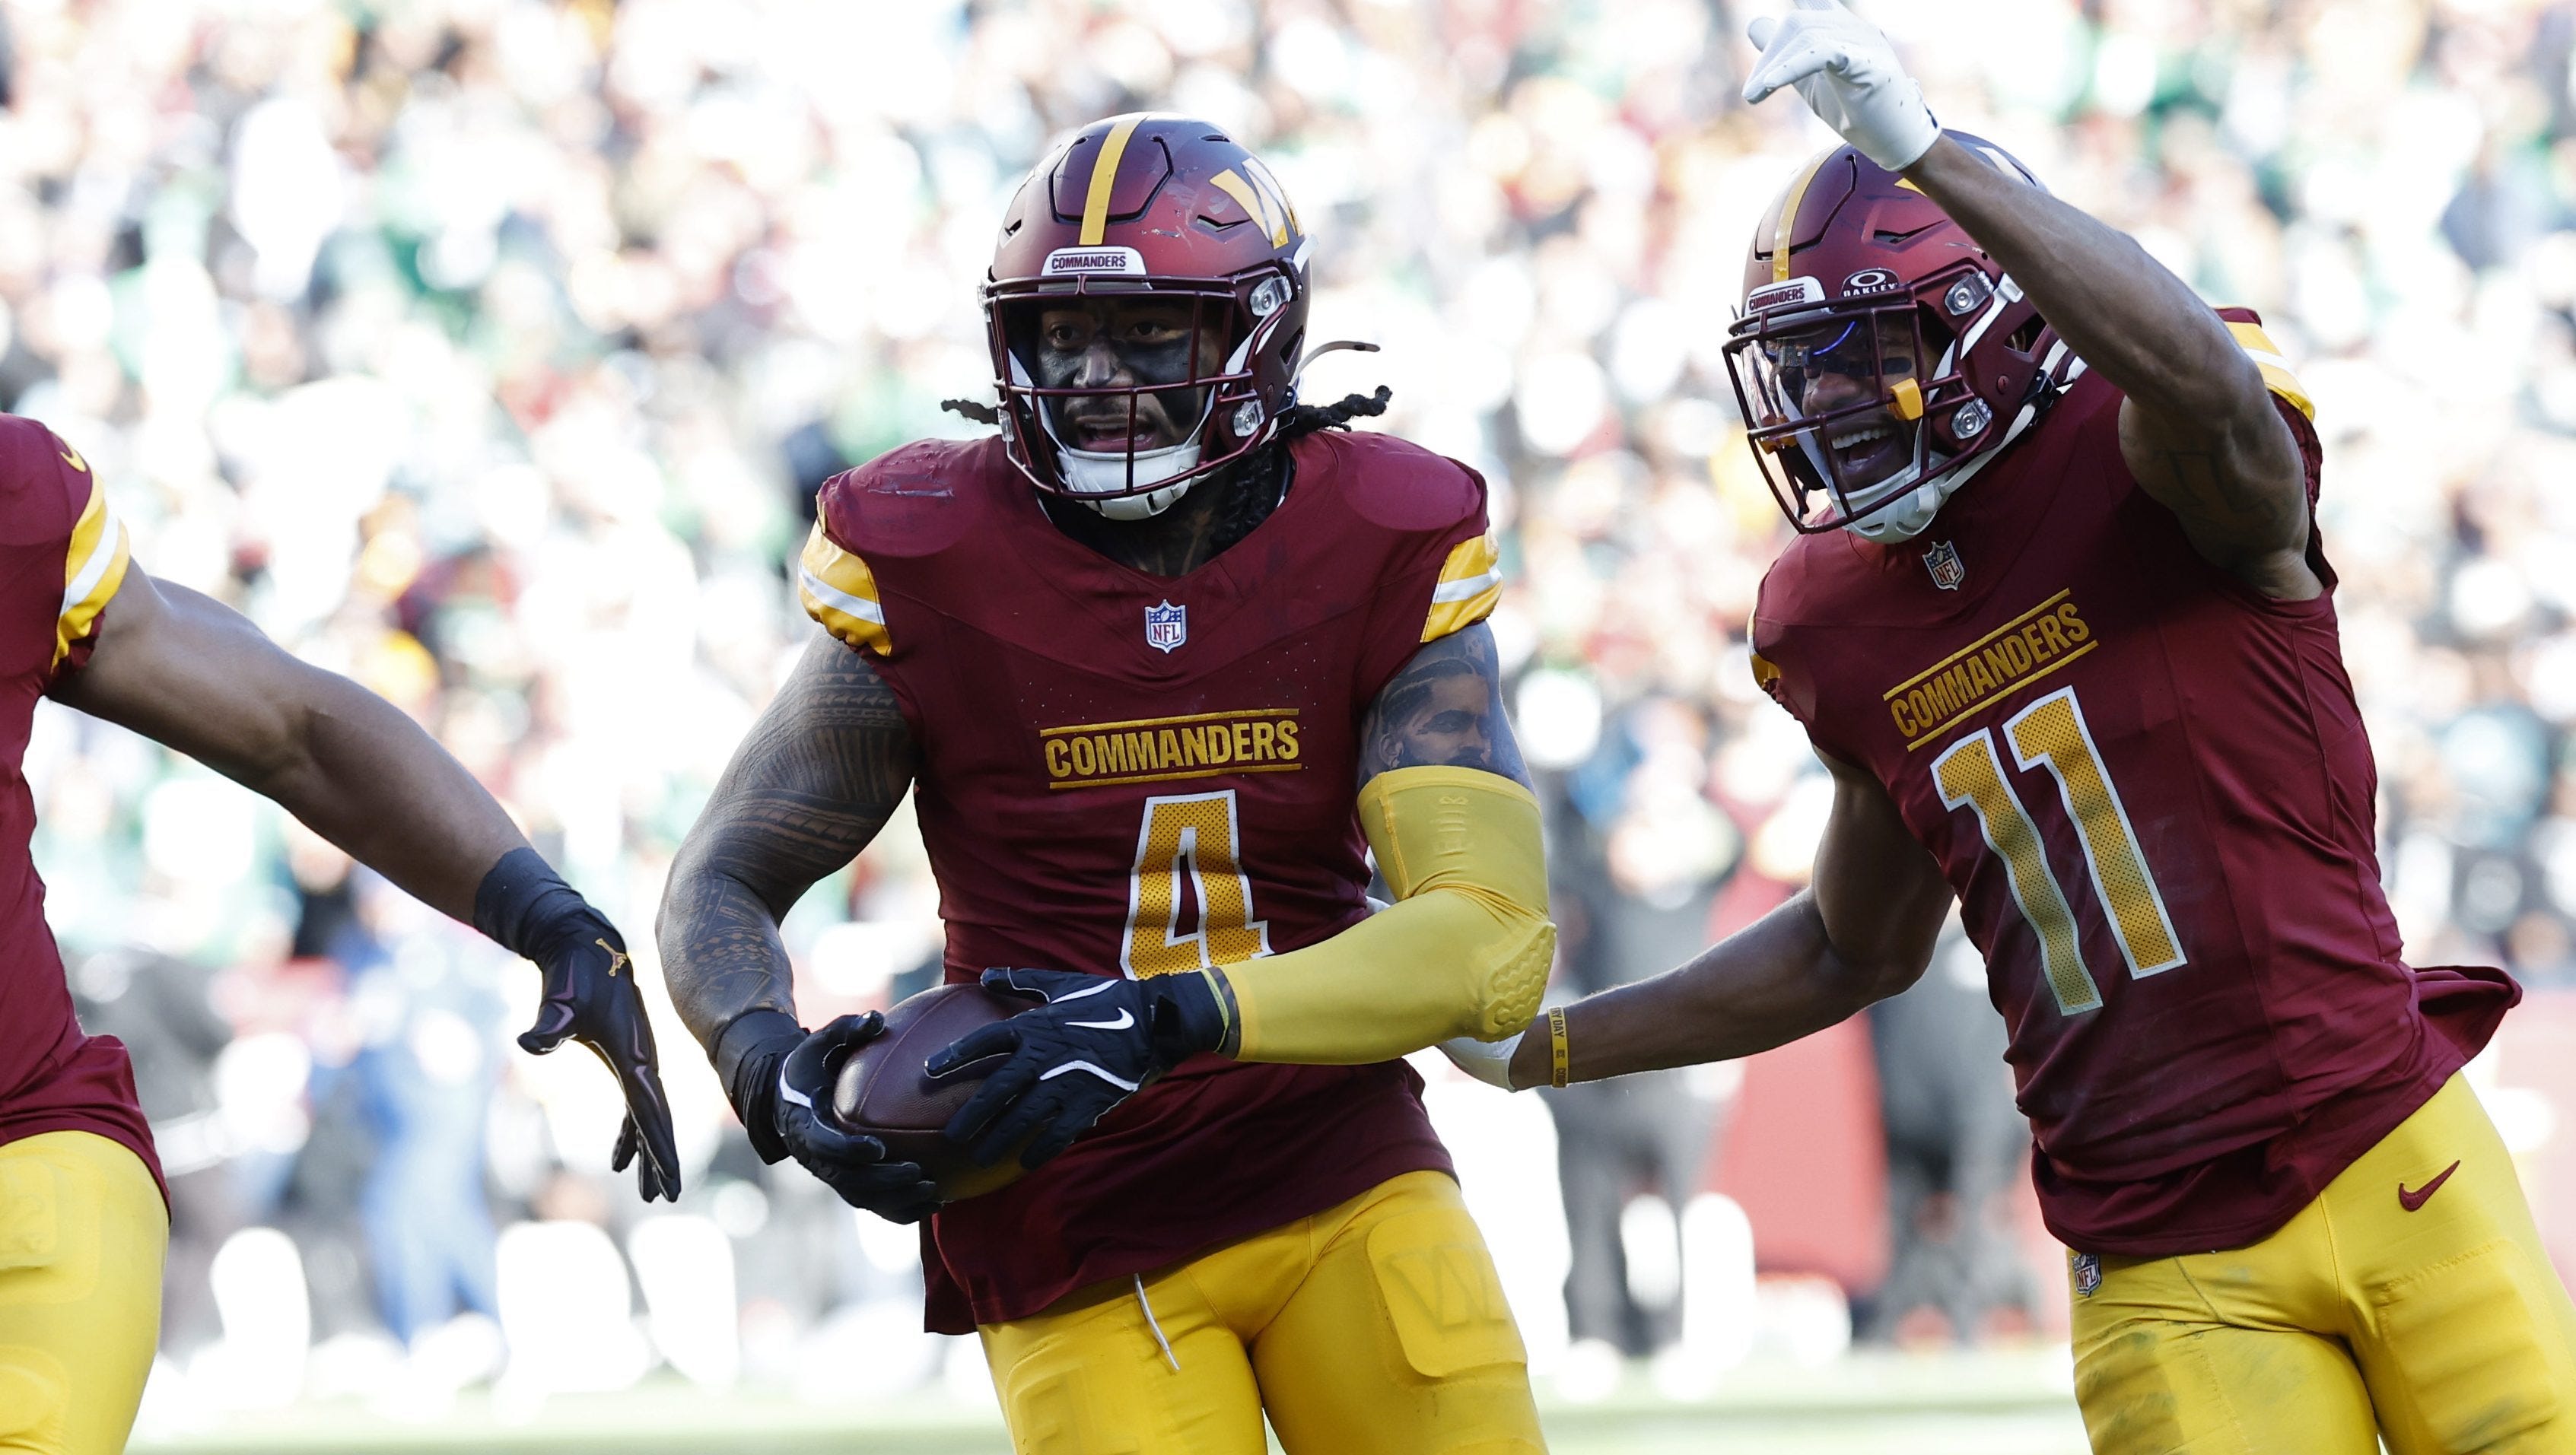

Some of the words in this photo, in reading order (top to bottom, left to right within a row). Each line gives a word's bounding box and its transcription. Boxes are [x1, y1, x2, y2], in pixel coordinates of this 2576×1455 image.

[1051, 256, 1126, 269] COMMANDERS
[1749, 288, 1805, 310] COMMANDERS
[1843, 283, 1897, 297] OAKLEY
[1935, 561, 1960, 583] NFL
[1152, 624, 1180, 643] NFL
[1891, 603, 2090, 737] COMMANDERS
[1045, 720, 1299, 777] COMMANDERS
[1930, 685, 2188, 1016] 11
[1119, 789, 1275, 981] 4
[1553, 1020, 1565, 1037] DAY
[2077, 1267, 2097, 1288] NFL
